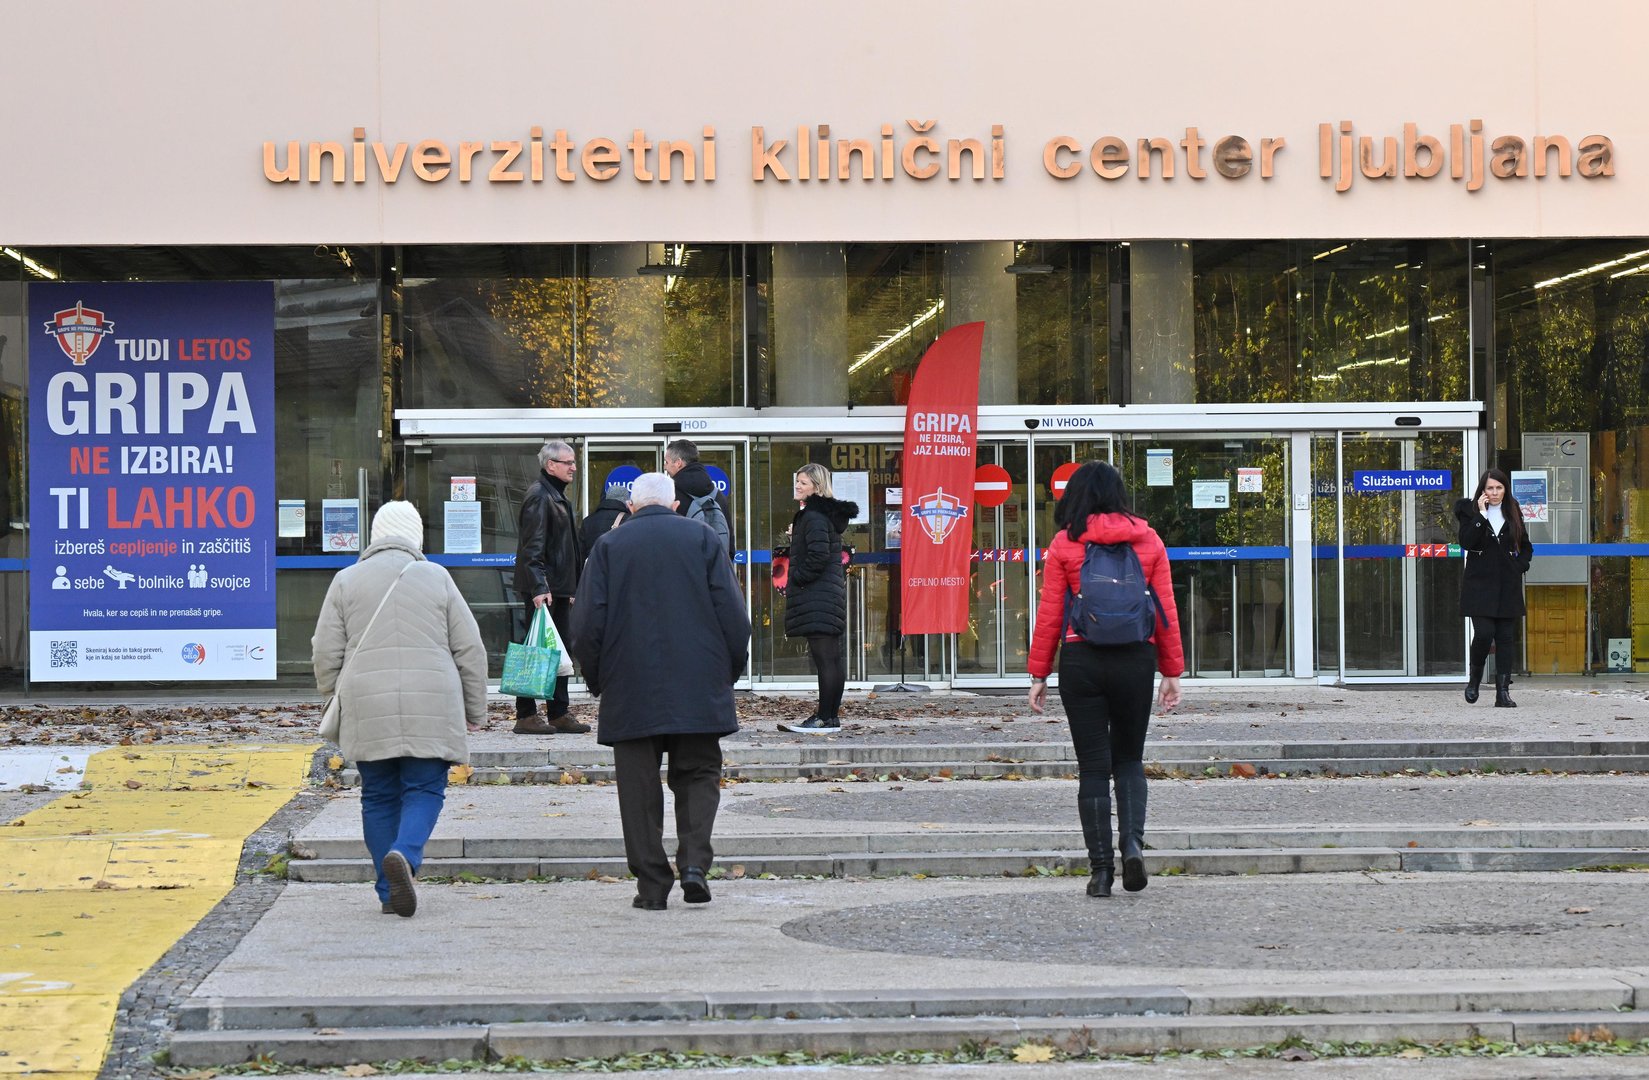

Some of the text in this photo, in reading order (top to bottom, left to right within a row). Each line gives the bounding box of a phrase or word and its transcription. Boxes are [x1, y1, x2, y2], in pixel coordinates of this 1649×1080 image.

[262, 120, 1615, 197] univerzitetni klinični center ljubljana
[115, 338, 251, 361] TUDI LETOS
[47, 372, 256, 435] GRIPA
[913, 413, 971, 433] GRIPA
[1043, 417, 1093, 429] NI VHODA
[920, 434, 964, 445] NE IZBIRA,
[70, 446, 233, 474] NE IZBIRA!
[831, 445, 903, 469] GRIP
[913, 445, 971, 456] JAZ LAHKO!
[1363, 475, 1442, 486] Službeni vhod
[50, 488, 89, 529] TI
[108, 486, 255, 528] LAHKO
[55, 538, 251, 557] izbereš cepljenje in zaščitiš
[75, 575, 250, 591] sebe bolnike svojce
[908, 577, 965, 587] CEPILNO MESTO
[84, 609, 104, 617] Hvala,
[130, 608, 148, 618] cepiš
[170, 608, 201, 617] prenašaš
[203, 608, 223, 617] gripe.
